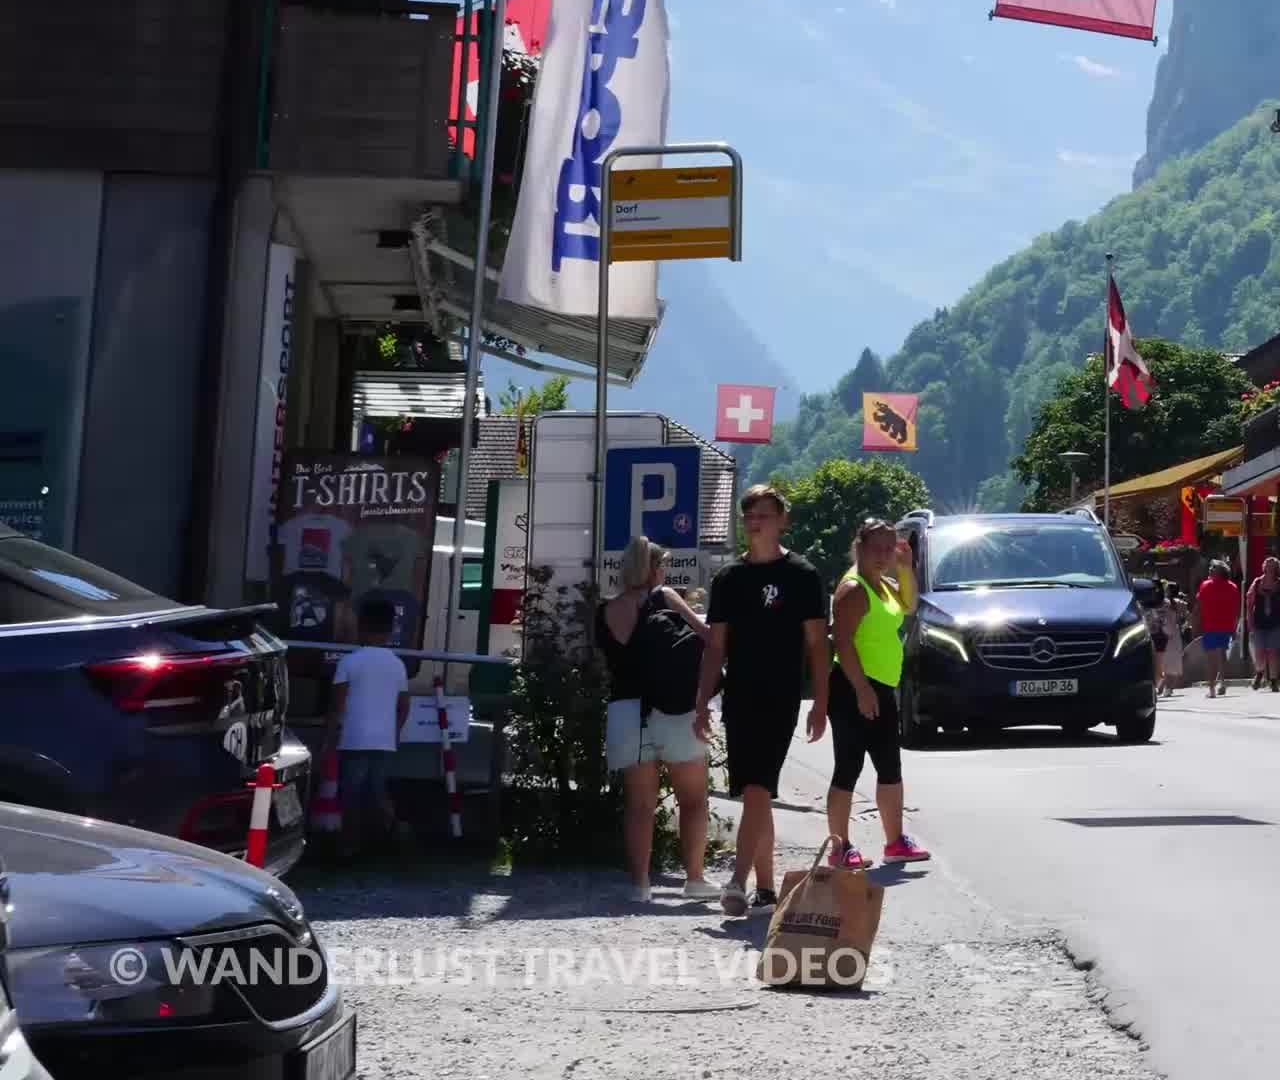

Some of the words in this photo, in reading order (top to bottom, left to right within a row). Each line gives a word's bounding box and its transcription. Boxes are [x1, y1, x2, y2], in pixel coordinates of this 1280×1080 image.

[615, 204, 639, 214] Dorf
[293, 471, 428, 508] T-SHIRTS
[631, 463, 676, 539] P
